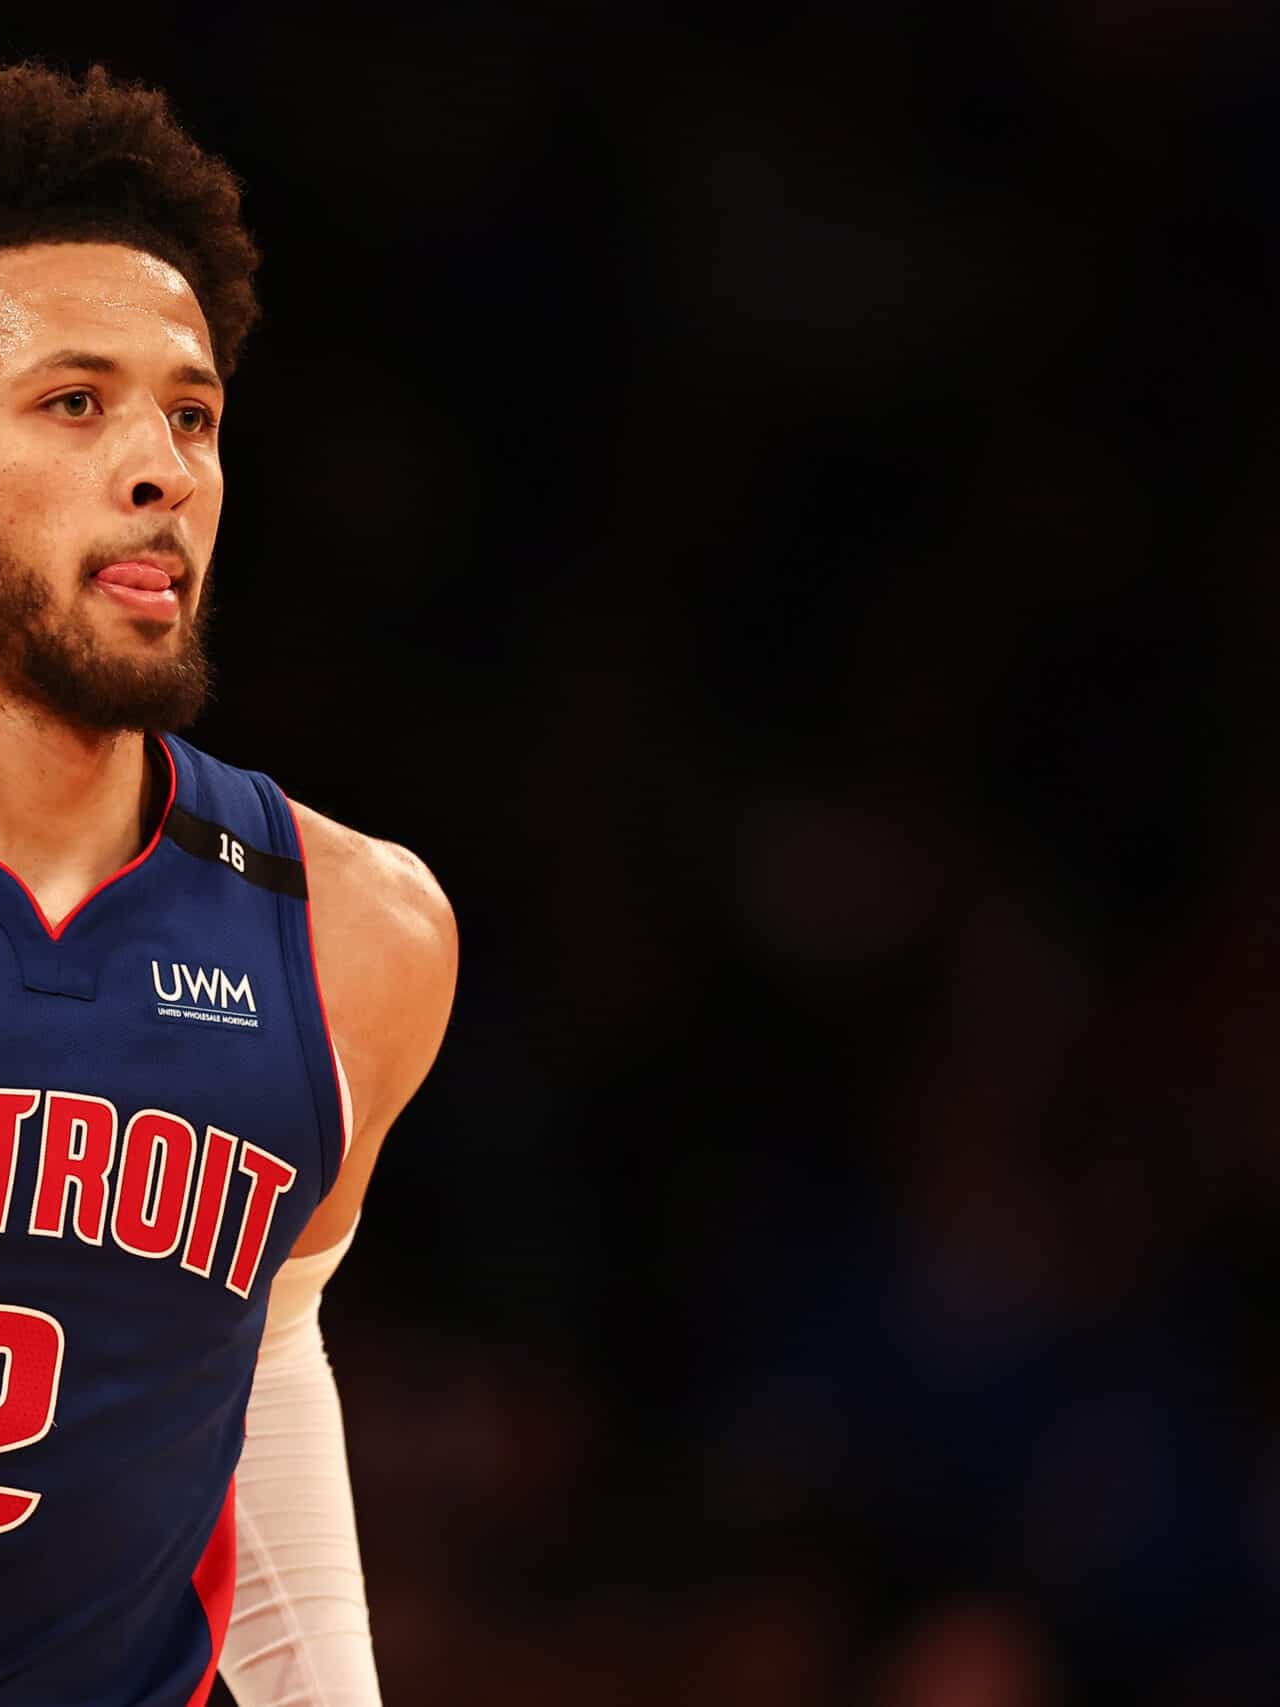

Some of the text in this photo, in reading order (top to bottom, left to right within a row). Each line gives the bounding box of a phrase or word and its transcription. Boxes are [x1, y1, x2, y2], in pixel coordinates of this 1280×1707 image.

[219, 832, 245, 873] 16
[151, 960, 257, 1012] UWM
[157, 1007, 259, 1028] UNITED WHOLESALE MORTGAGE
